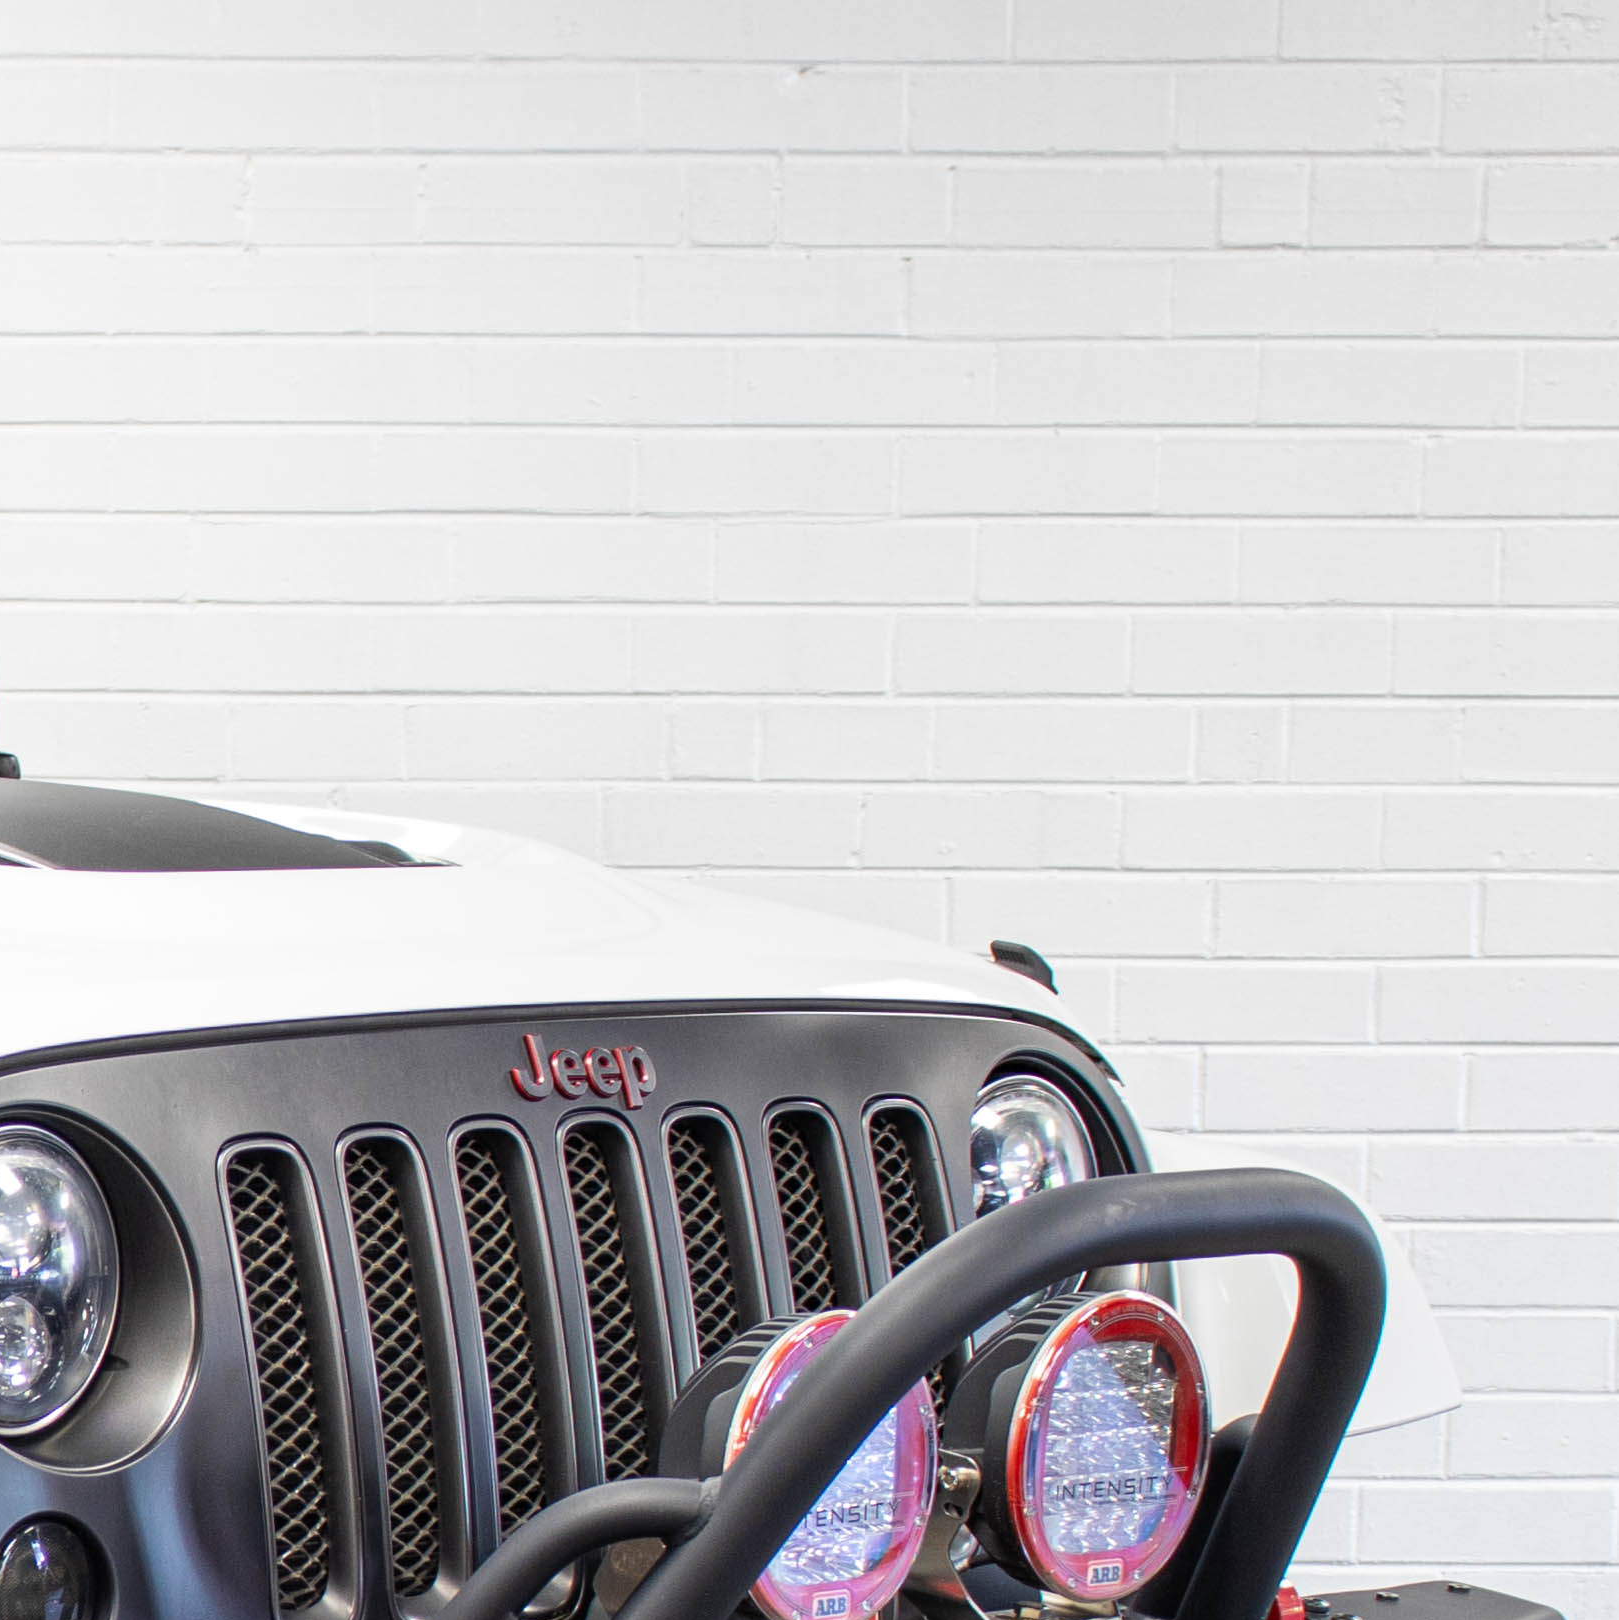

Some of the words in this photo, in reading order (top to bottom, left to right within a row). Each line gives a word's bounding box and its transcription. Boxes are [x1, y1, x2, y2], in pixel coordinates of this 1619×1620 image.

[509, 1032, 657, 1110] Jeep
[1055, 1475, 1173, 1502] INTENSITY
[804, 1500, 903, 1529] TENSITY
[1089, 1565, 1121, 1586] ARB
[814, 1595, 847, 1618] ARB
